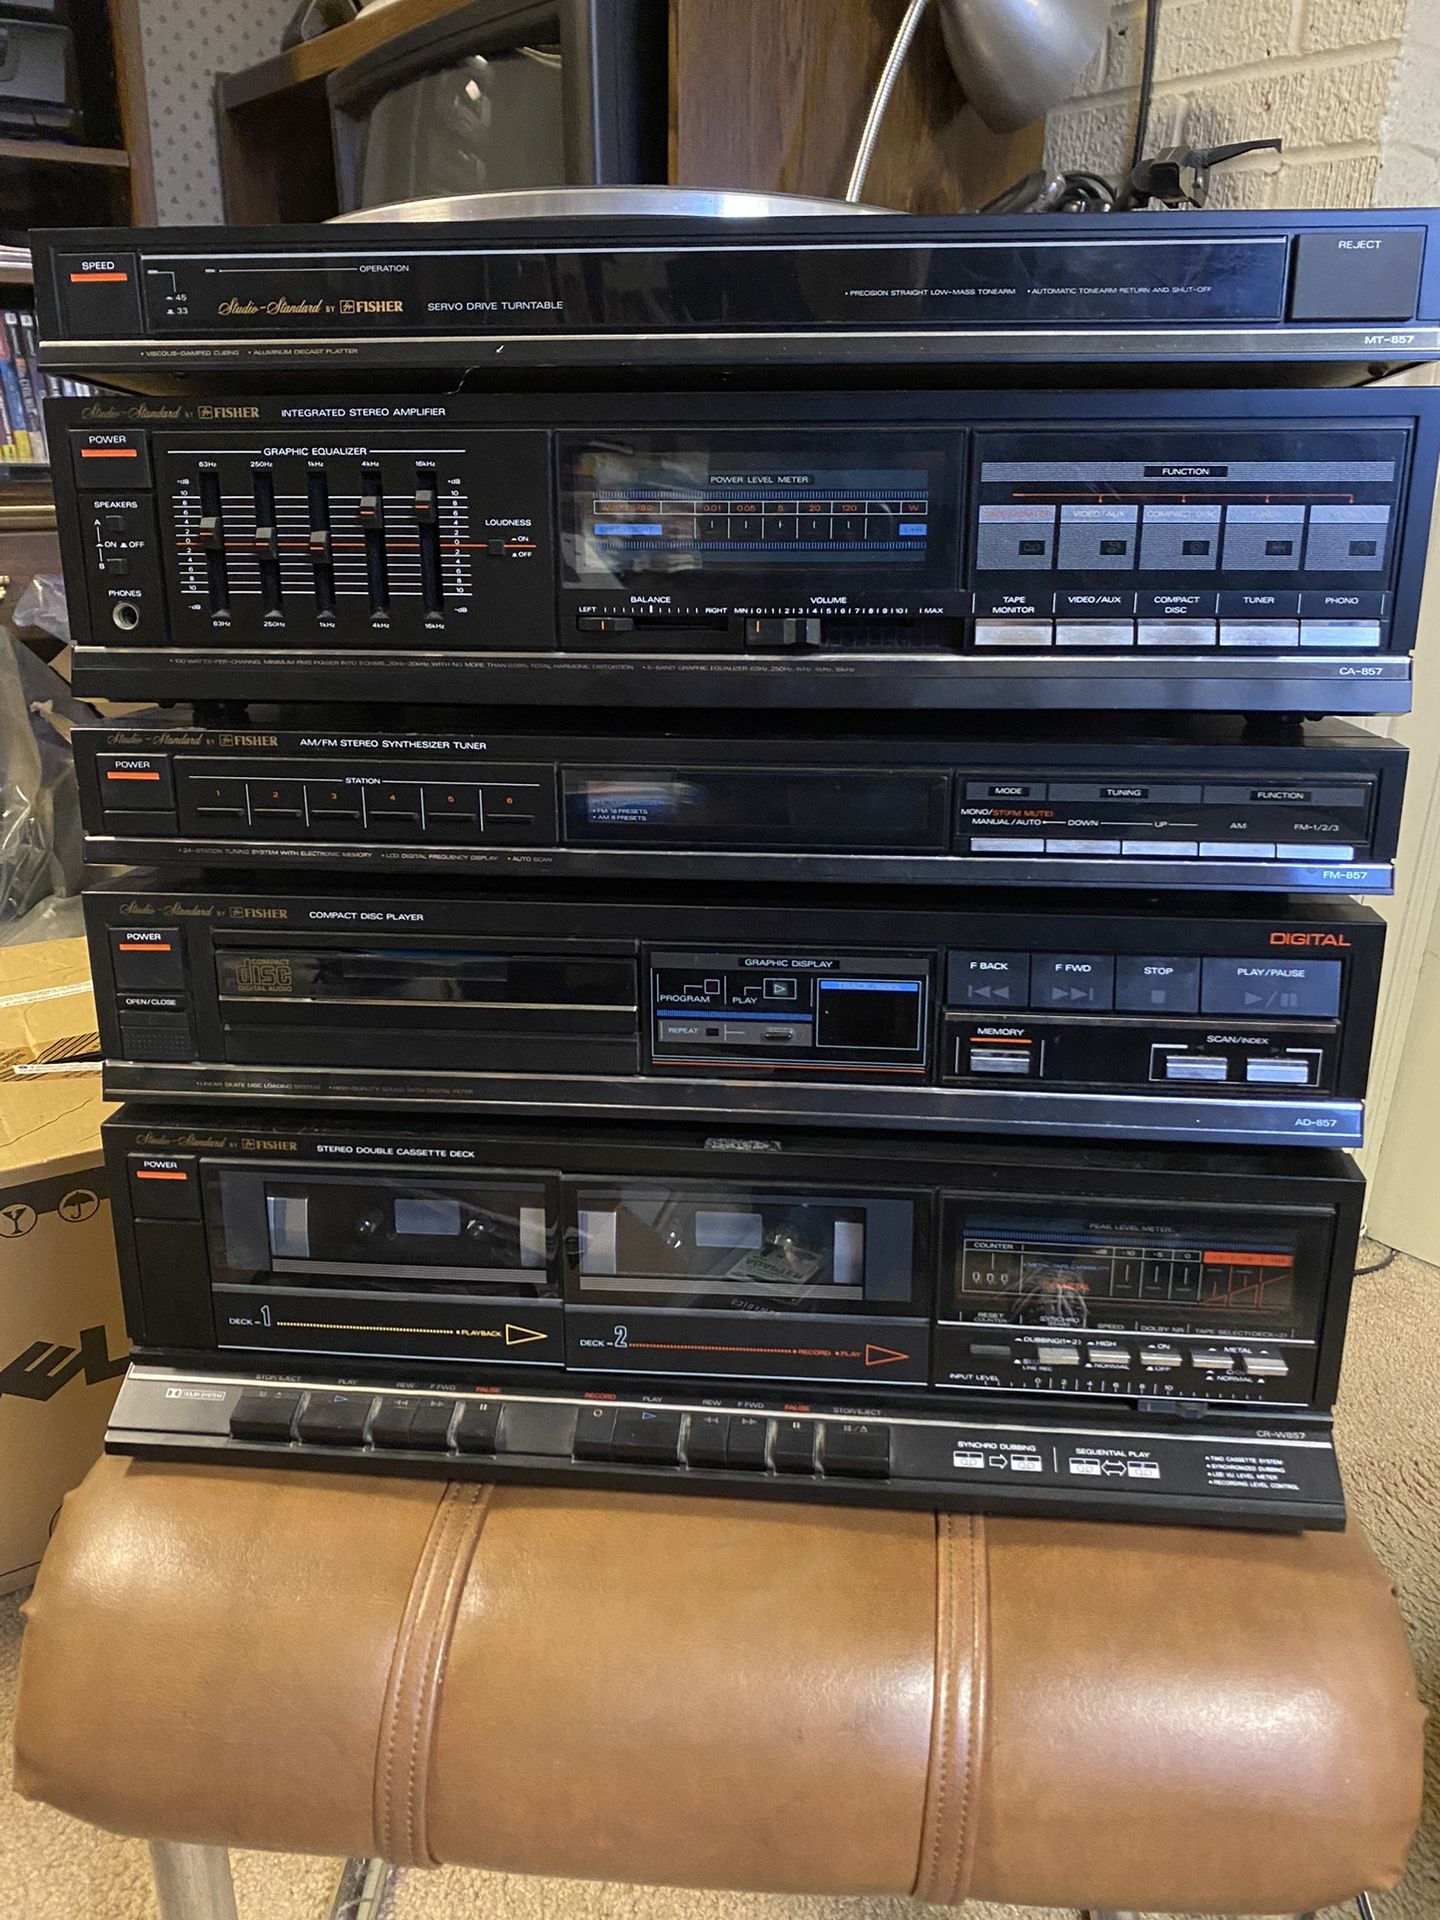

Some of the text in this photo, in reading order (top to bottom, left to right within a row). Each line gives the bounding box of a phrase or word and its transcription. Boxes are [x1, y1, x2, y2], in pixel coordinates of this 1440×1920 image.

[1338, 240, 1383, 249] REJECT
[82, 261, 115, 270] SPEED
[359, 264, 409, 273] OPERATION
[850, 288, 1016, 297] PRECISION STRAIGHT LOW-MASS TONEARM
[1031, 286, 1213, 296] AUTOMATIC TONEARM RETURN AND SHUT-OFF
[175, 294, 188, 302] 45
[356, 301, 404, 313] FISHER
[427, 301, 564, 311] SERVO DRIVE TURNTABLE
[1364, 336, 1416, 345] MT-857
[326, 348, 359, 356] PLATTER
[214, 406, 260, 418] FISHER
[281, 406, 447, 417] INTEGRATED STEREO AMPLIFIER
[89, 435, 127, 444] POWER
[263, 446, 368, 456] GRAPHIC EQUALIZER
[250, 461, 274, 469] 250Hz
[1162, 467, 1211, 476] FUNCTION
[710, 475, 809, 484] POWER LEVEL METER
[94, 501, 139, 510] SPEAKERS
[809, 504, 822, 512] 20
[485, 519, 533, 528] LOUDNESS
[517, 535, 530, 543] ON
[104, 540, 118, 549] ON
[128, 540, 146, 549] OFF
[518, 550, 534, 559] OFF
[108, 589, 143, 598] PHONES
[630, 595, 671, 604] BALANCE
[810, 596, 847, 604] VOLUME
[1002, 596, 1026, 604] TAPE
[1067, 596, 1121, 604] VIDEO/AUX
[1153, 596, 1201, 604] COMPACT
[1243, 596, 1275, 604] TUNER
[1324, 597, 1359, 605] PHONO
[578, 605, 597, 613] LEFT
[992, 606, 1035, 614] MONITOR
[1164, 606, 1187, 614] DISC
[263, 621, 287, 629] 250Hz
[1338, 666, 1384, 676] CA-857
[233, 735, 279, 747] FISHER
[300, 739, 487, 750] AM/FM STEREO SYNTHESIZER TUNER
[115, 760, 151, 769] POWER
[345, 776, 381, 785] STATION
[994, 787, 1023, 795] MODE
[1106, 788, 1142, 797] TUNING
[1257, 791, 1304, 800] FUNCTION
[971, 818, 1042, 826] MANUAL/AUTO
[1229, 822, 1247, 830] AM
[1293, 824, 1340, 832] FM-1/2/3
[1322, 870, 1368, 880] FM-857
[244, 908, 288, 919] FISHER
[309, 911, 424, 921] COMPACT DISC PLAYER
[127, 933, 162, 941] POWER
[1269, 932, 1352, 947] DIGITAL
[744, 958, 834, 969] GRAPHIC DISPLAY
[979, 962, 1009, 971] BACK
[1065, 964, 1092, 972] FWD
[1143, 966, 1174, 975] STOP
[1237, 967, 1306, 978] PLAY/PAUSE
[125, 998, 177, 1007] OPEN/CLOSE
[659, 994, 711, 1003] PROGRAM
[732, 996, 758, 1005] PLAY
[668, 1026, 699, 1034] REPEAT
[977, 1027, 1025, 1036] MEMORY
[1206, 1034, 1270, 1045] SCAN/INDEX
[1294, 1118, 1338, 1127] AD-857
[256, 1140, 298, 1151] FISHER
[316, 1144, 476, 1158] STEREO DOUBLE CASSETTE DECK
[143, 1160, 178, 1169] POWER
[973, 1240, 1014, 1250] COUNTER
[461, 1329, 502, 1337] PLAYBACK
[1095, 1340, 1117, 1348] HIGH
[840, 1350, 861, 1358] PLAY
[1223, 1346, 1253, 1355] METAL
[1093, 1362, 1130, 1371] NORMAL
[975, 1375, 1000, 1383] LEVEL
[1216, 1375, 1254, 1384] NORMAL
[642, 1395, 663, 1403] PLAY
[1256, 1429, 1307, 1440] CR-W857
[957, 1440, 998, 1450] SYNCHRO
[1075, 1447, 1151, 1459] SEQUENTIAL PLAY
